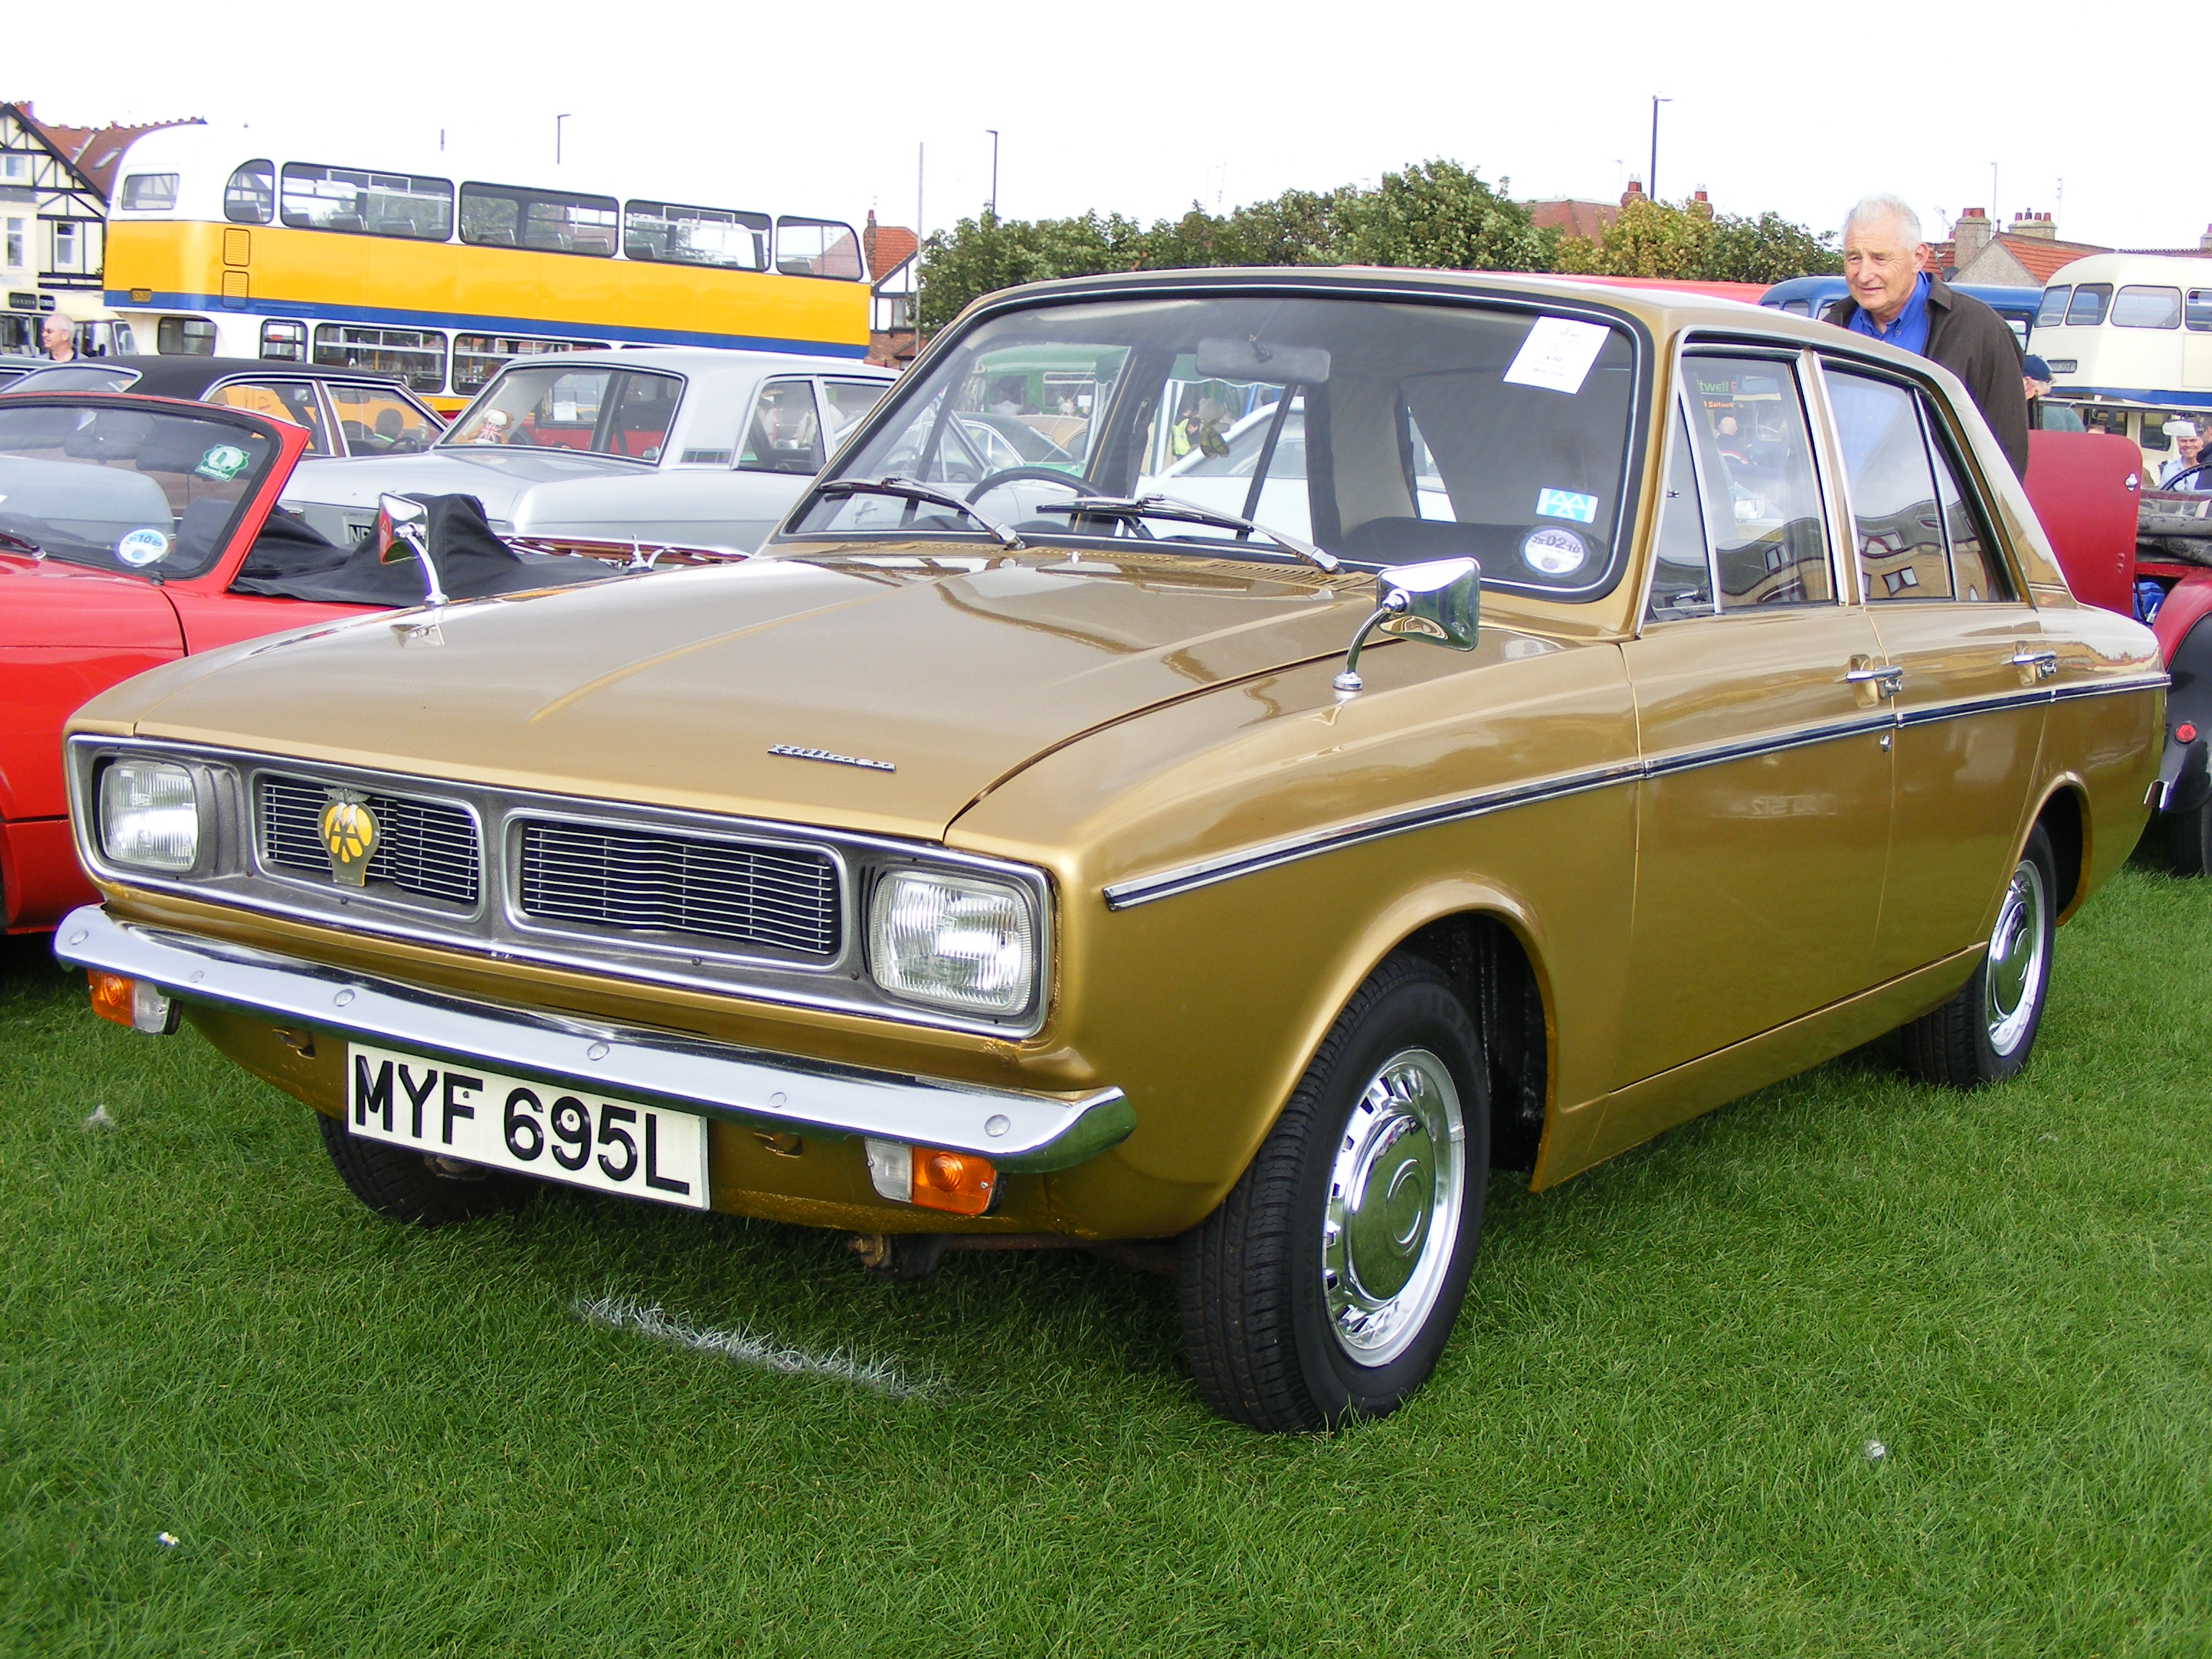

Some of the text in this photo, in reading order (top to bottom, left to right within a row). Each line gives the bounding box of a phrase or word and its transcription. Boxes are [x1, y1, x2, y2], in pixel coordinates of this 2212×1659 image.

[767, 744, 896, 773] Hillman
[355, 1054, 691, 1195] MYF 695L
